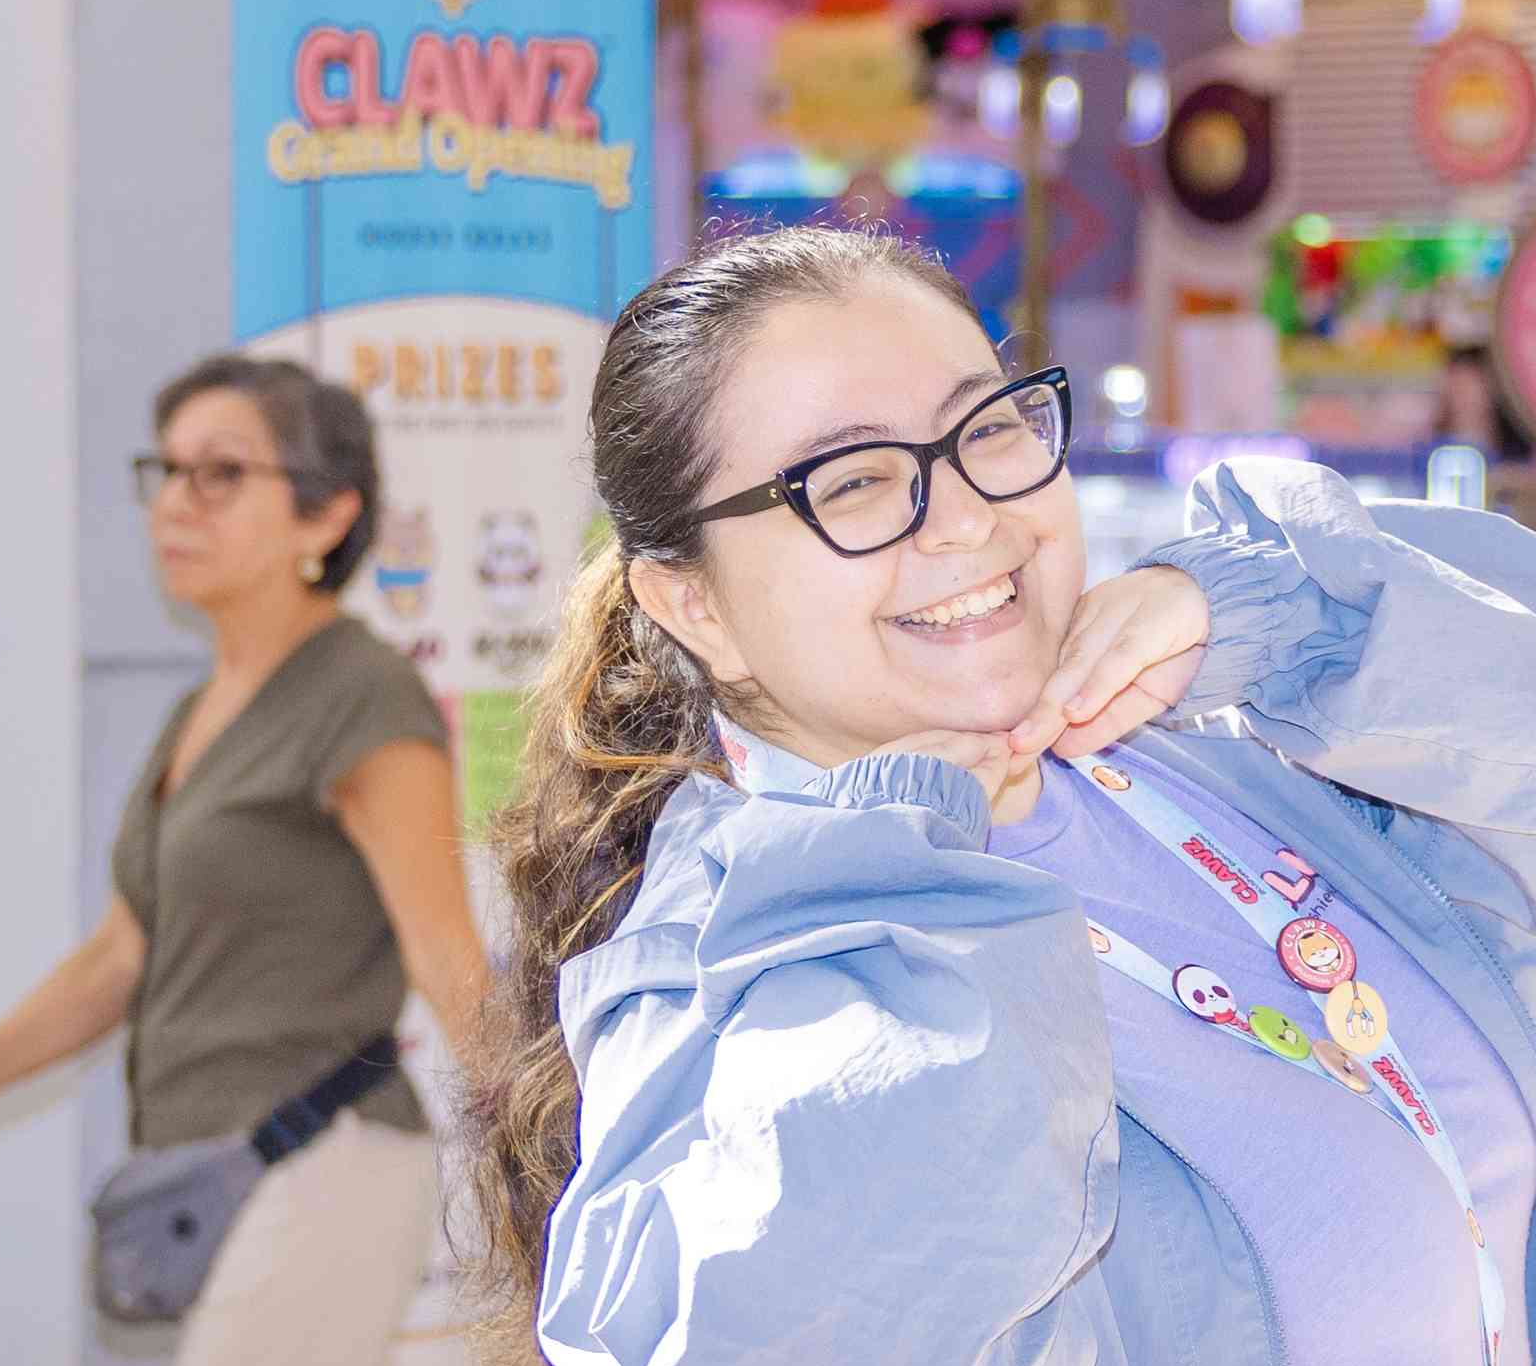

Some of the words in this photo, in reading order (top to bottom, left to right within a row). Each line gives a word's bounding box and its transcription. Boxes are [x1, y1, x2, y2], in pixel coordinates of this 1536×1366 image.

[294, 24, 600, 142] CLAWZ
[351, 340, 564, 404] PRIZES
[1180, 836, 1258, 904] CLAWZ
[1283, 920, 1329, 947] CLAWZ
[1370, 1055, 1436, 1136] CLAWZ
